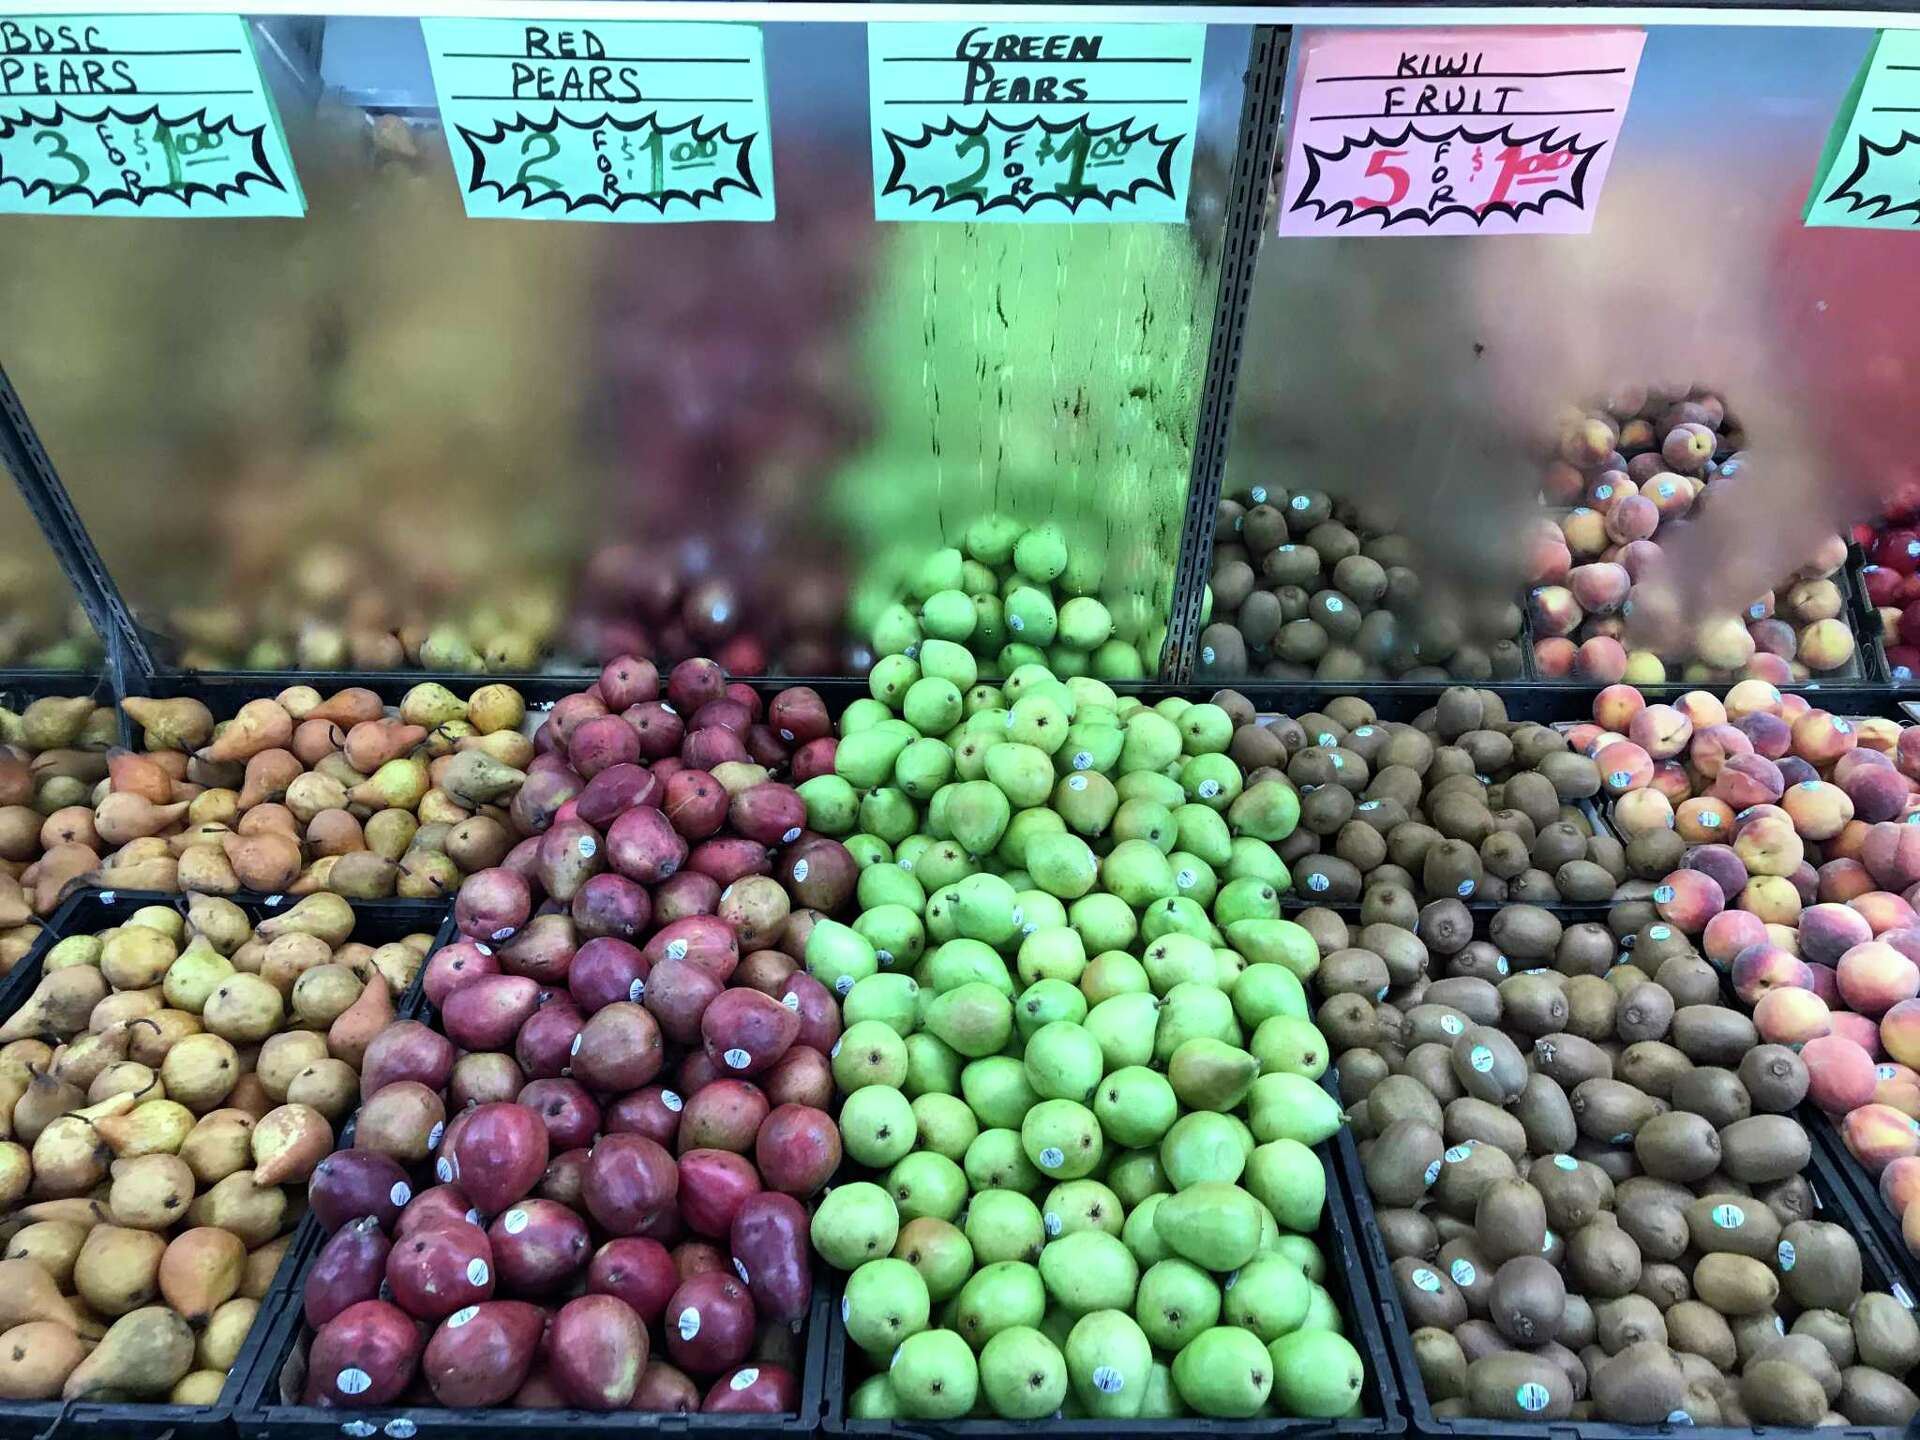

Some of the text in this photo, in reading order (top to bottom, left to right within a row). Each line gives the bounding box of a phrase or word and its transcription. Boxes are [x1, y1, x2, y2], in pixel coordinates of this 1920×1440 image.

[526, 27, 606, 60] RED
[956, 27, 1103, 61] GREEN
[0, 58, 137, 94] PEARS
[512, 63, 642, 103] PEARS
[963, 58, 1089, 105] PEARS
[1398, 52, 1483, 77] KIWI
[1384, 85, 1523, 117] FRUIT
[33, 130, 90, 191] 3
[517, 132, 565, 190] 2
[946, 133, 990, 198] 2
[1353, 150, 1411, 208] 5
